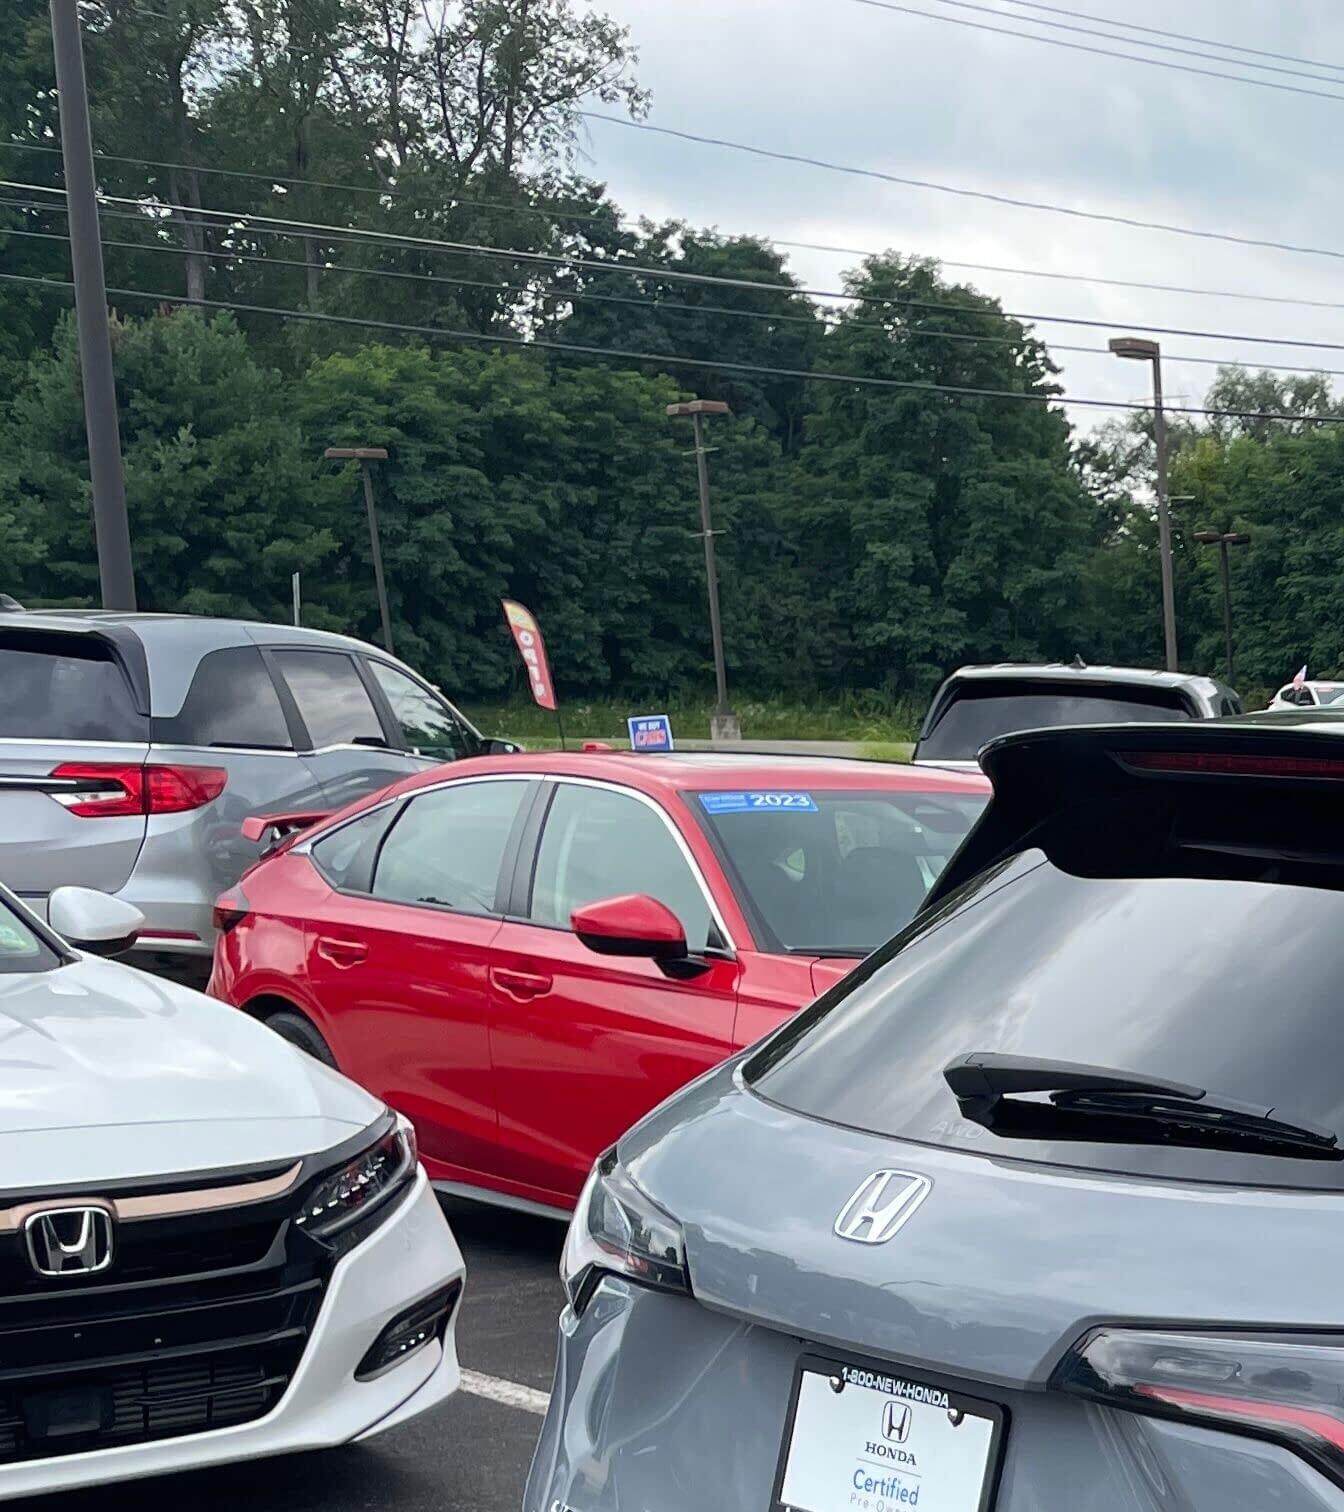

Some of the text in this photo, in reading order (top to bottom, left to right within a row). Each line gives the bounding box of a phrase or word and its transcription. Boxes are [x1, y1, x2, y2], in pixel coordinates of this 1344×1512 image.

[750, 793, 811, 807] 2023
[840, 1366, 950, 1409] 1-800-NEW-HONDA
[864, 1441, 917, 1466] HONDA
[852, 1468, 920, 1505] Certified
